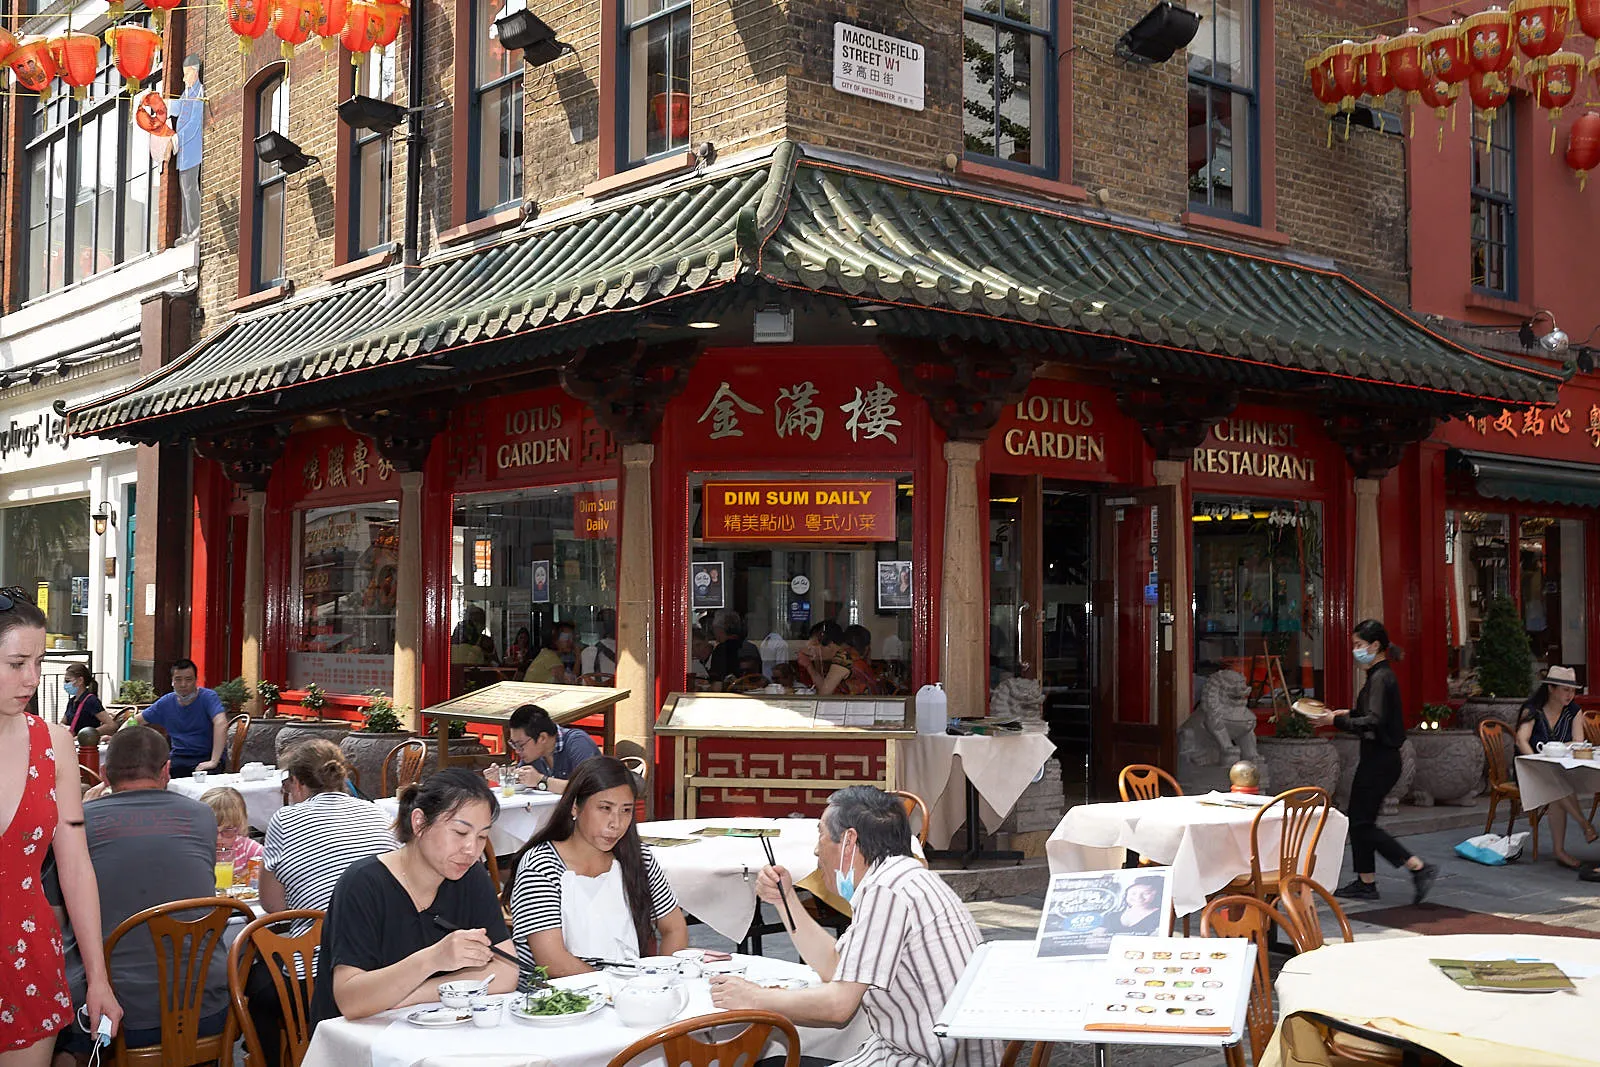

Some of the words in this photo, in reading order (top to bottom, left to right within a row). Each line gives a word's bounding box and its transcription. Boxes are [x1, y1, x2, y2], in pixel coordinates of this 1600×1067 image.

[842, 45, 881, 67] STREET
[884, 56, 900, 72] W1
[843, 29, 918, 61] MACCLESFIELD
[842, 61, 894, 86] 麥高田街
[841, 81, 853, 90] CITY
[861, 87, 896, 100] WESTMINSTER
[505, 404, 562, 436] LOTUS
[697, 381, 902, 444] 金滿樓
[1016, 395, 1094, 427] LOTUS
[0, 414, 42, 460] plings'
[1005, 428, 1104, 462] GARDEN
[1214, 418, 1299, 448] CHINESE
[497, 436, 570, 469] GARDEN
[1193, 447, 1316, 482] RESTAURANT
[579, 500, 597, 513] Dim
[724, 491, 760, 505] DIM
[766, 491, 809, 505] SUM
[816, 491, 872, 505] DAILY
[586, 518, 610, 533] Daily
[723, 513, 796, 532] 精美點心
